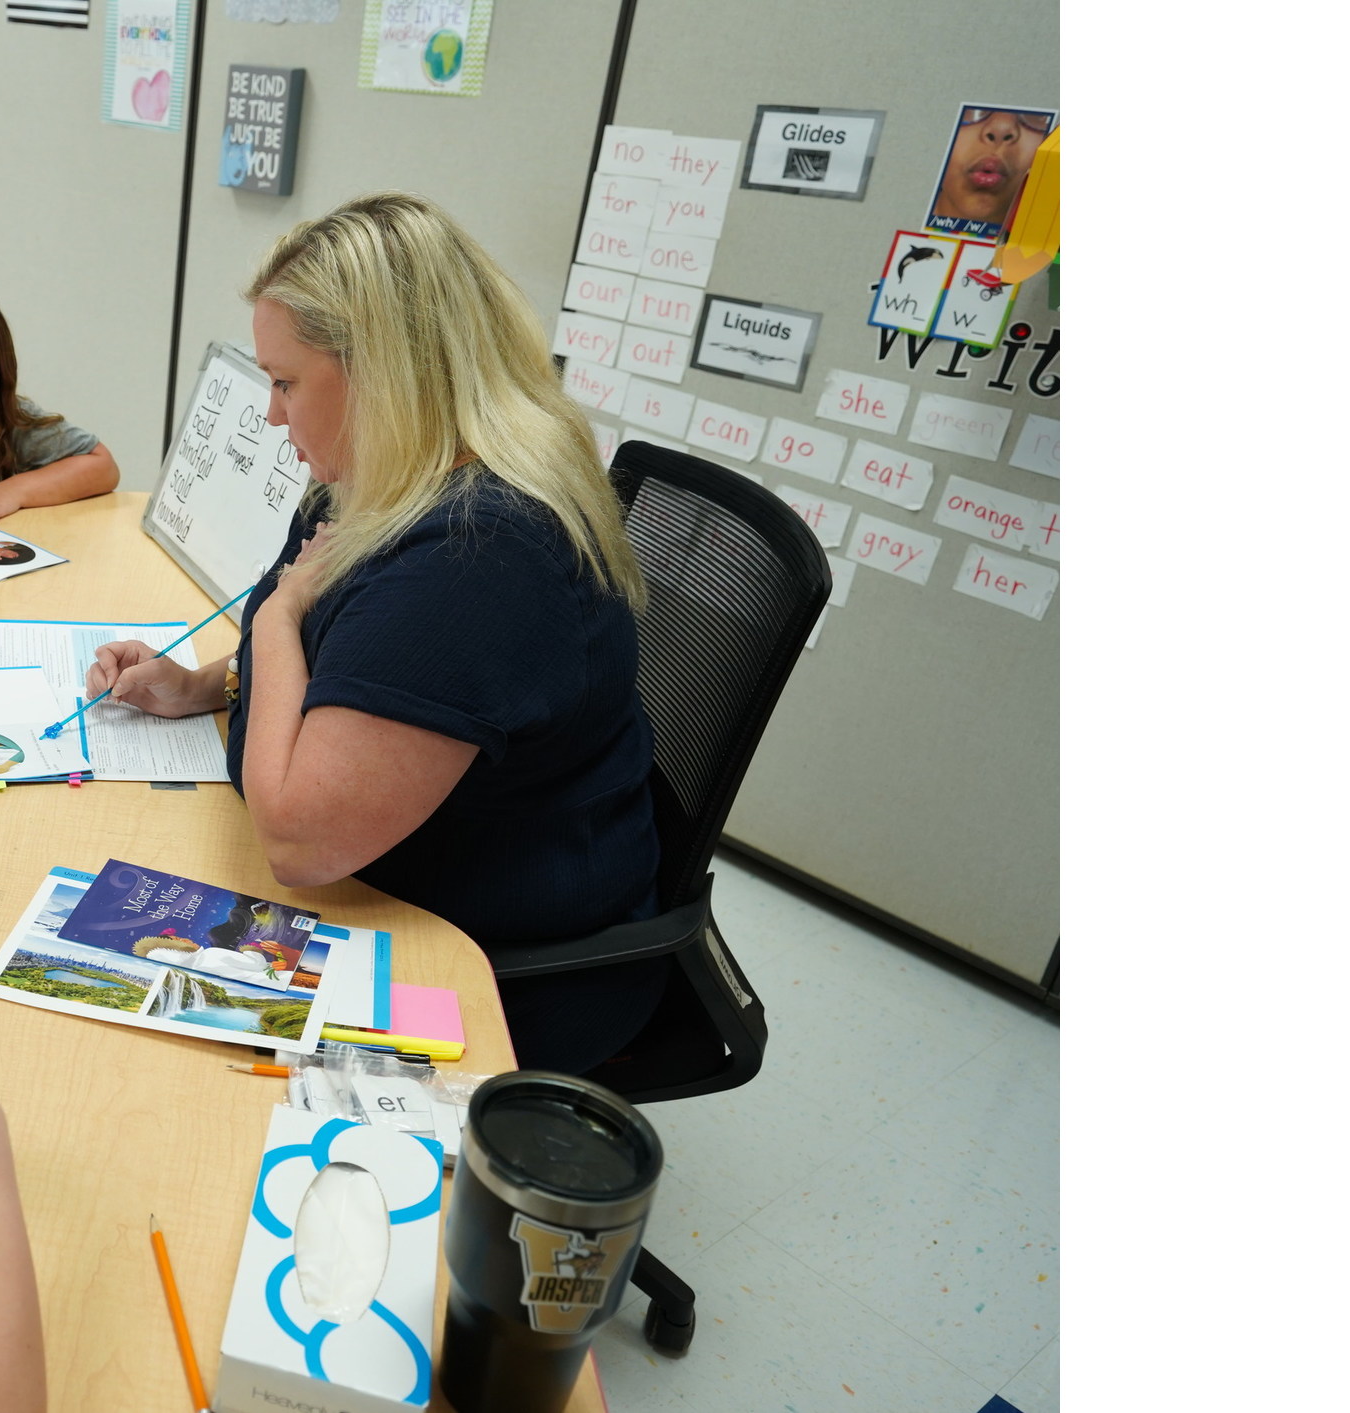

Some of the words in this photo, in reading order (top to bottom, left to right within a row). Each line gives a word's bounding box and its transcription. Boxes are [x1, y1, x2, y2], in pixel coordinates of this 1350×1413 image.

[386, 5, 406, 23] SEE
[415, 6, 431, 24] IN
[231, 71, 250, 94] BE
[251, 74, 286, 98] KIND
[228, 97, 246, 120] BE
[249, 100, 285, 125] TRUE
[231, 123, 263, 146] JUST
[263, 126, 282, 149] BE
[782, 123, 847, 145] Glides
[245, 150, 279, 179] YOU
[614, 142, 644, 163] no
[670, 146, 719, 186] they
[601, 182, 637, 213] for
[666, 200, 706, 226] you
[588, 231, 632, 258] are
[650, 248, 698, 272] one
[579, 280, 623, 303] our
[641, 293, 690, 321] run
[723, 311, 792, 340] Liquids
[566, 327, 617, 362] very
[633, 340, 675, 366] out
[206, 374, 233, 407] old
[570, 367, 614, 409] they
[840, 384, 887, 419] she
[643, 394, 661, 417] is
[192, 407, 217, 438] bold
[701, 417, 749, 446] can
[919, 411, 994, 441] green
[178, 430, 218, 478] blindfold
[775, 436, 814, 463] go
[170, 469, 195, 499] scold
[864, 460, 913, 489] eat
[263, 472, 288, 507] bolt
[157, 491, 193, 540] household
[947, 495, 1025, 539] orange
[858, 531, 923, 572] gray
[973, 556, 1027, 596] her
[123, 887, 152, 913] Most
[142, 875, 160, 890] of
[155, 883, 185, 906] Way
[172, 894, 203, 921] Home
[147, 903, 170, 920] the
[377, 1096, 406, 1112] er
[529, 1277, 607, 1304] JASPER
